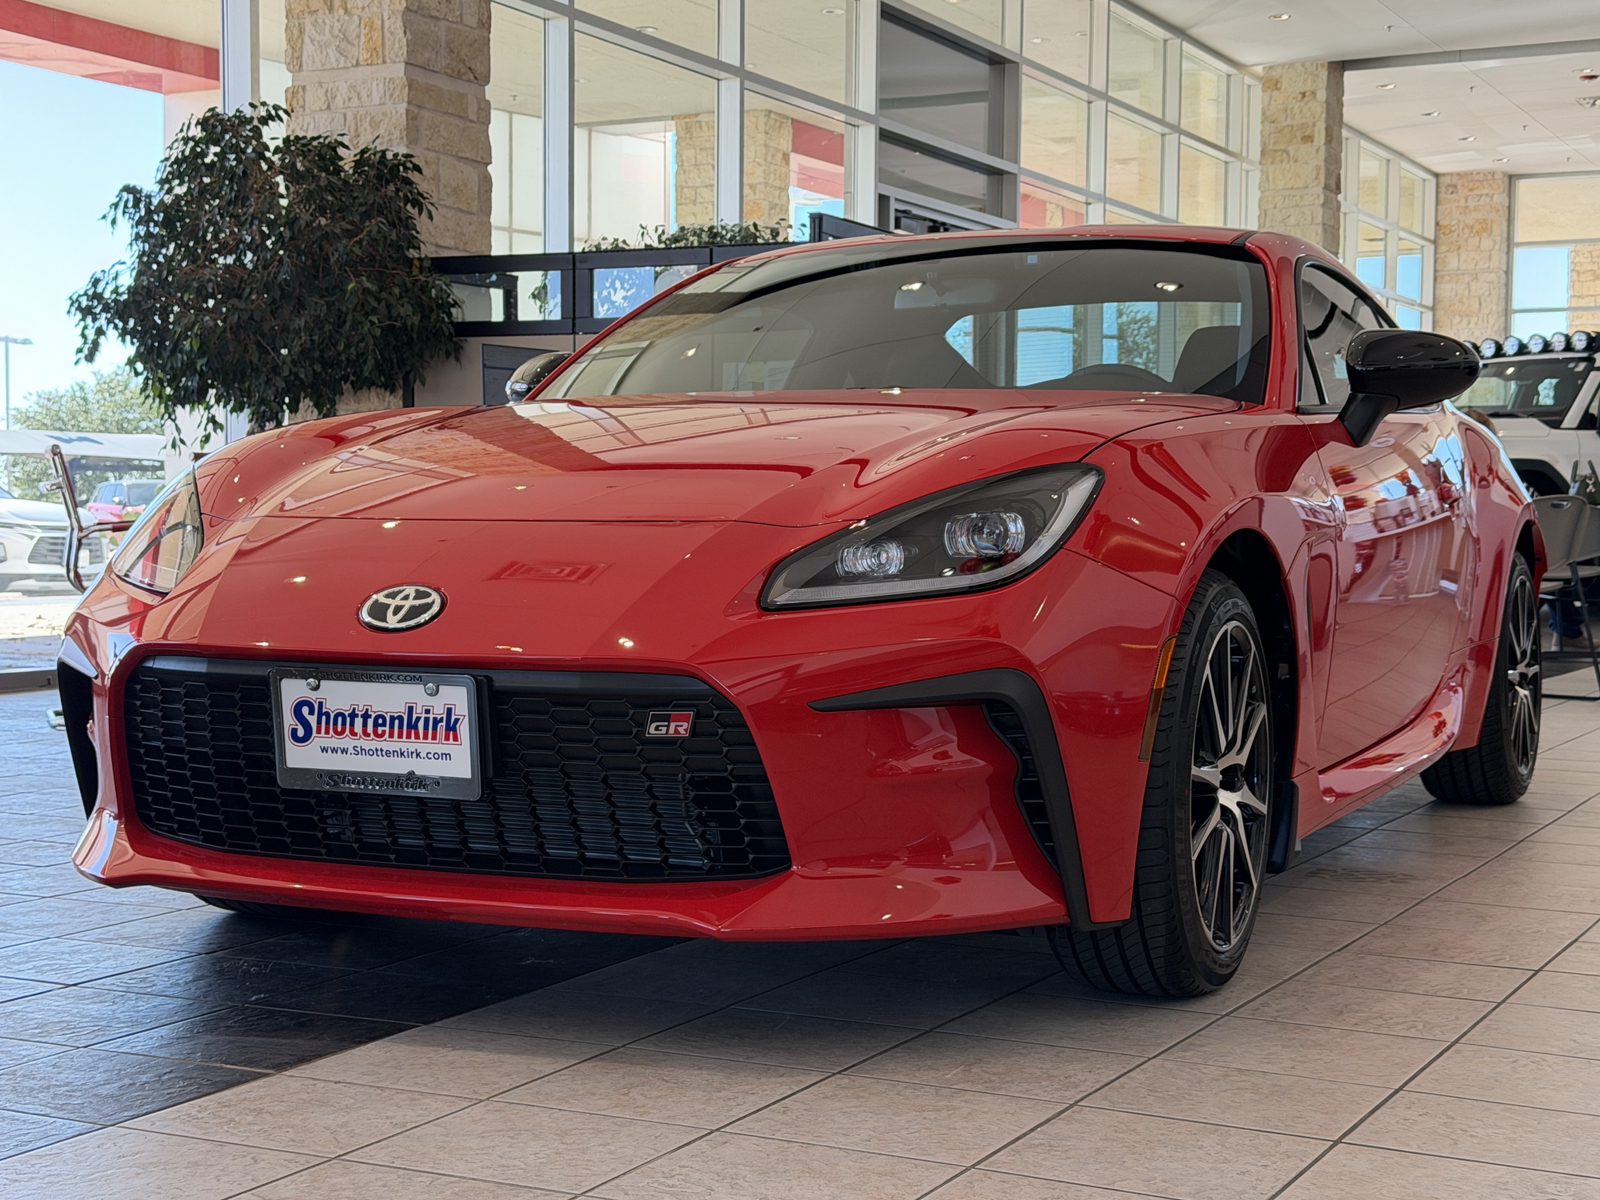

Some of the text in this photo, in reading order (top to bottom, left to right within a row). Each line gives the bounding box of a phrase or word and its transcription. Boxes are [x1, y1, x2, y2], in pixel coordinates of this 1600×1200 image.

[319, 671, 423, 683] SHOTTENKIRK.COM
[289, 697, 465, 747] Shottenkirk
[649, 722, 688, 734] GR
[319, 745, 452, 761] www.Shottenkirk.com
[323, 773, 432, 792] Shottenkirk
